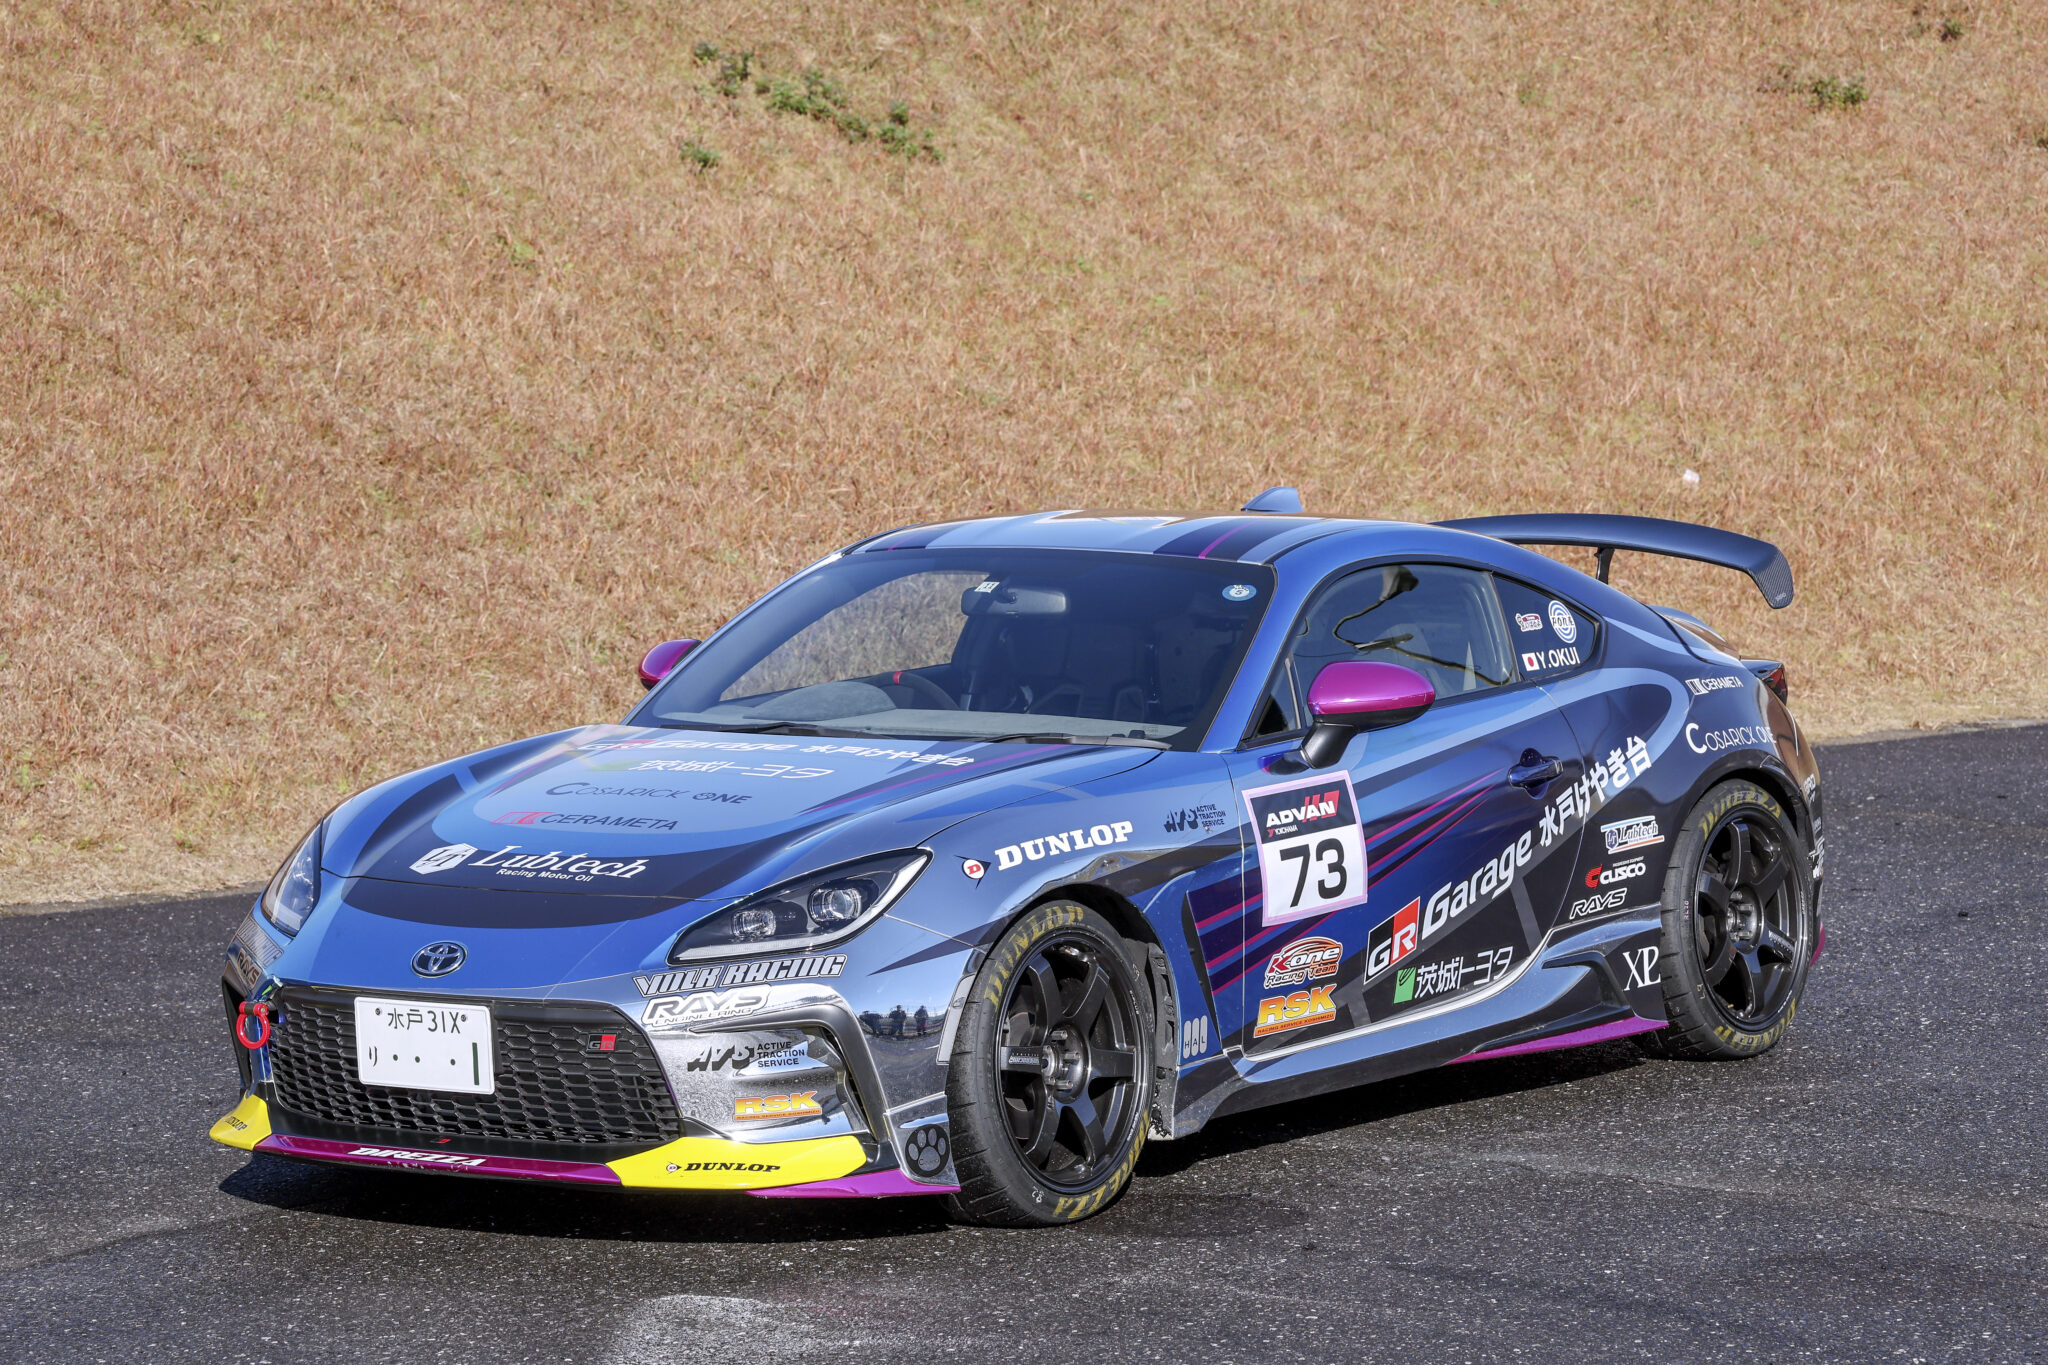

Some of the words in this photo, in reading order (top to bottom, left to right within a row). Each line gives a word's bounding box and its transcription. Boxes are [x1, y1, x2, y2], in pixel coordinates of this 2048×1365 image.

[1536, 647, 1580, 669] Y.OKUI
[1701, 676, 1744, 691] CERAMETA
[639, 740, 799, 752] Garage
[1685, 723, 1757, 754] COSARICK
[628, 760, 835, 779] 茨城トヨタ
[547, 781, 690, 799] COSARICK
[1196, 804, 1216, 813] ACTIVE
[1198, 810, 1226, 820] TRACTION
[1266, 801, 1336, 827] ADVAN
[540, 813, 680, 831] CERAMETA
[1620, 821, 1659, 841] Lubtech
[994, 820, 1134, 871] DUNLOP
[468, 845, 650, 879] Lubtech
[1367, 922, 1418, 977] GR
[1421, 831, 1533, 940] Garage
[1539, 735, 1653, 847] 水戸けやき台
[496, 868, 535, 879] Racing
[538, 870, 574, 882] Motor
[575, 874, 595, 883] Oil
[1279, 838, 1348, 908] 73
[1569, 888, 1628, 920] RAYS
[632, 965, 724, 997] VOLK
[719, 954, 848, 988] RACING
[1265, 970, 1305, 985] Racing
[1309, 963, 1337, 977] Team
[1415, 946, 1513, 999] 茨城トヨタ
[647, 989, 764, 1019] RAYS
[1258, 984, 1337, 1025] RSK
[655, 1008, 752, 1026] ENGINEERING
[757, 1041, 792, 1051] ACTIVE
[757, 1049, 806, 1059] TRACTION
[368, 1046, 378, 1067] り
[757, 1058, 800, 1068] SERVICE
[735, 1091, 820, 1114] RSK
[347, 1147, 487, 1166] DIREZZA
[684, 1162, 781, 1173] DUNLOP
